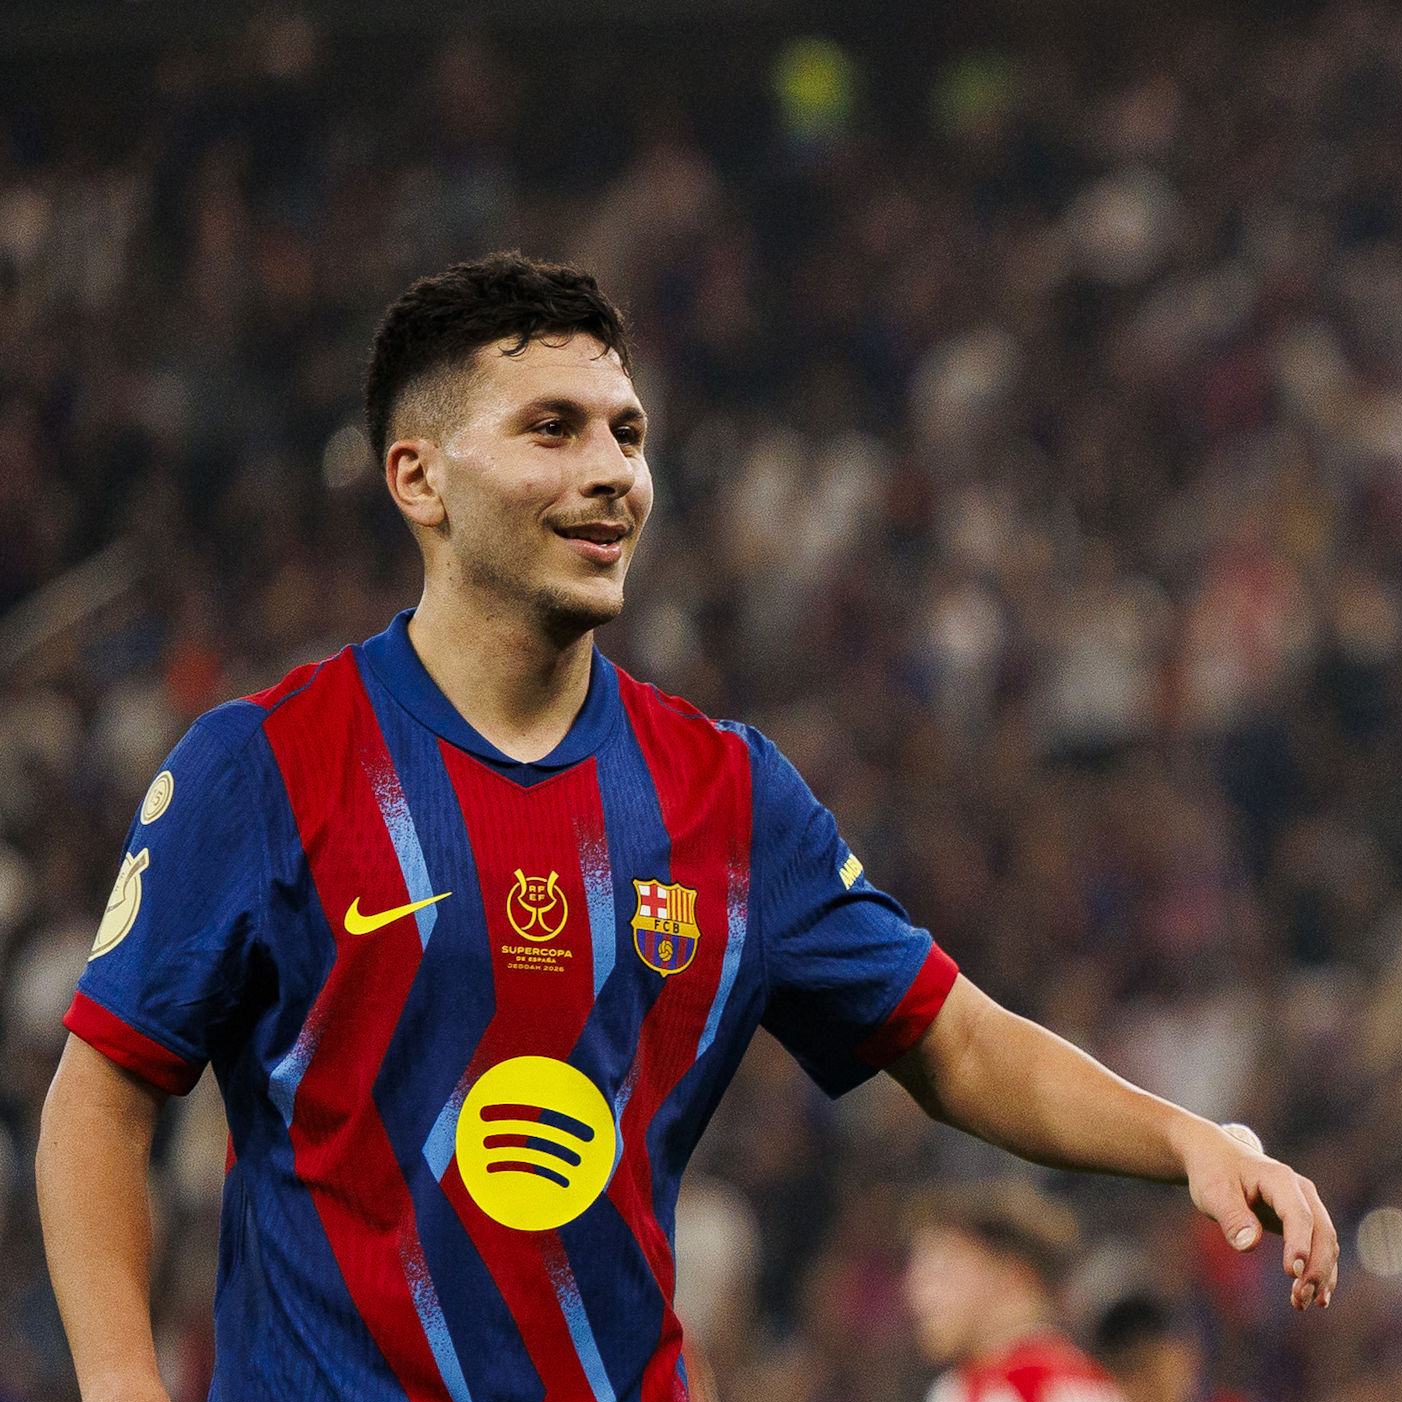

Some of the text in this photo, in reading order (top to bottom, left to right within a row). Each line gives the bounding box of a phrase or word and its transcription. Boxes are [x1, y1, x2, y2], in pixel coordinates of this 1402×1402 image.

[654, 919, 680, 934] FCB
[501, 945, 573, 958] SUPERCOPA
[507, 963, 541, 971] JEDDAH
